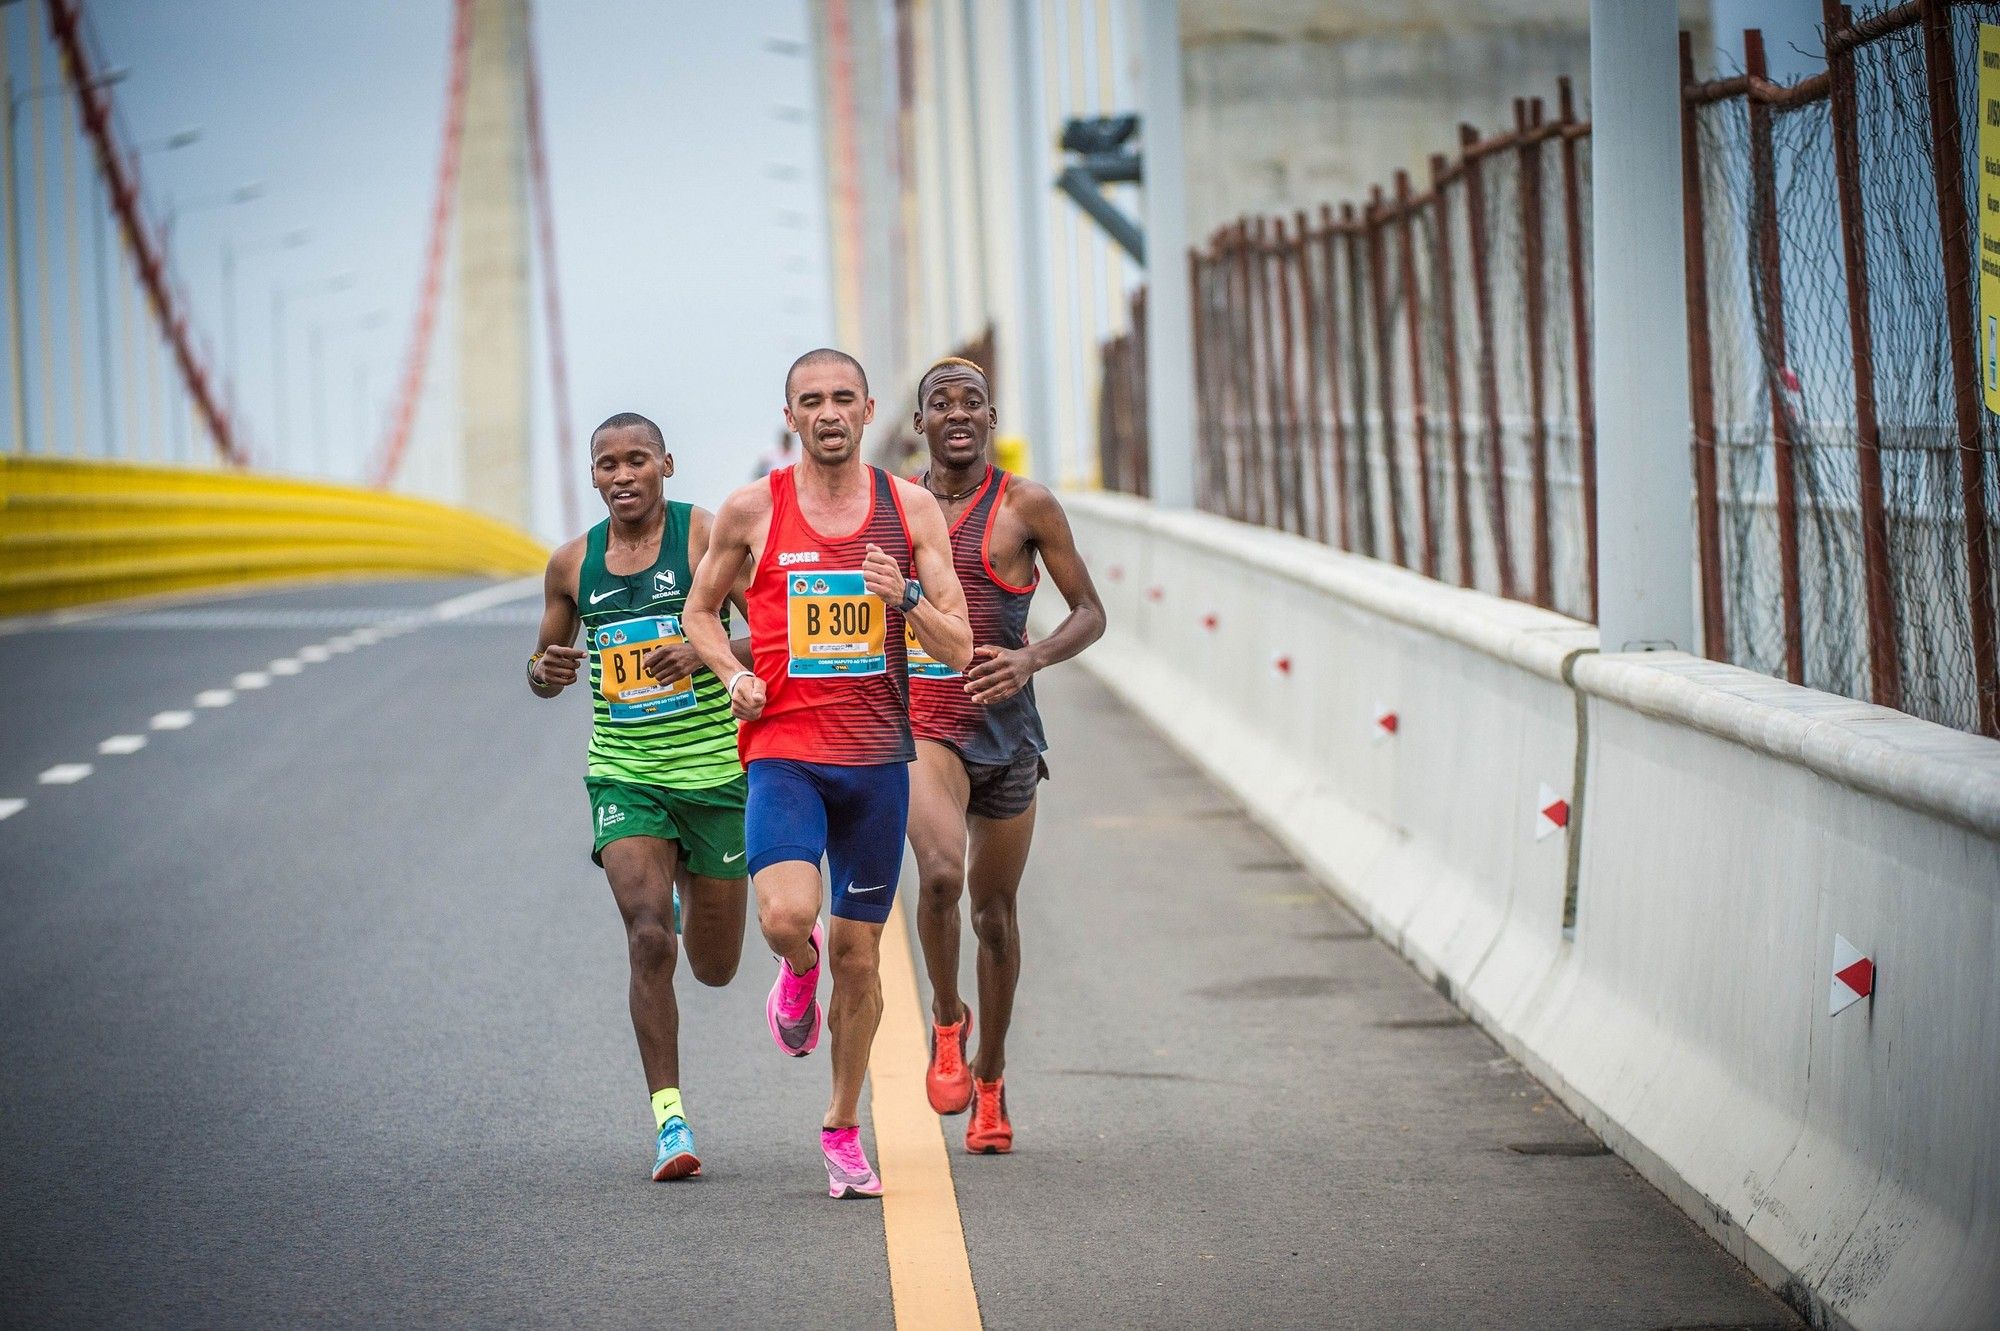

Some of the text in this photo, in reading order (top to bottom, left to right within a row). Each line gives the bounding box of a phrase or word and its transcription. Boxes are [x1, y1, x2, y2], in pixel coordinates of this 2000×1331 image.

[652, 590, 680, 600] NEDBANK
[807, 603, 820, 636] B
[829, 602, 870, 636] 300
[613, 645, 663, 684] B 75
